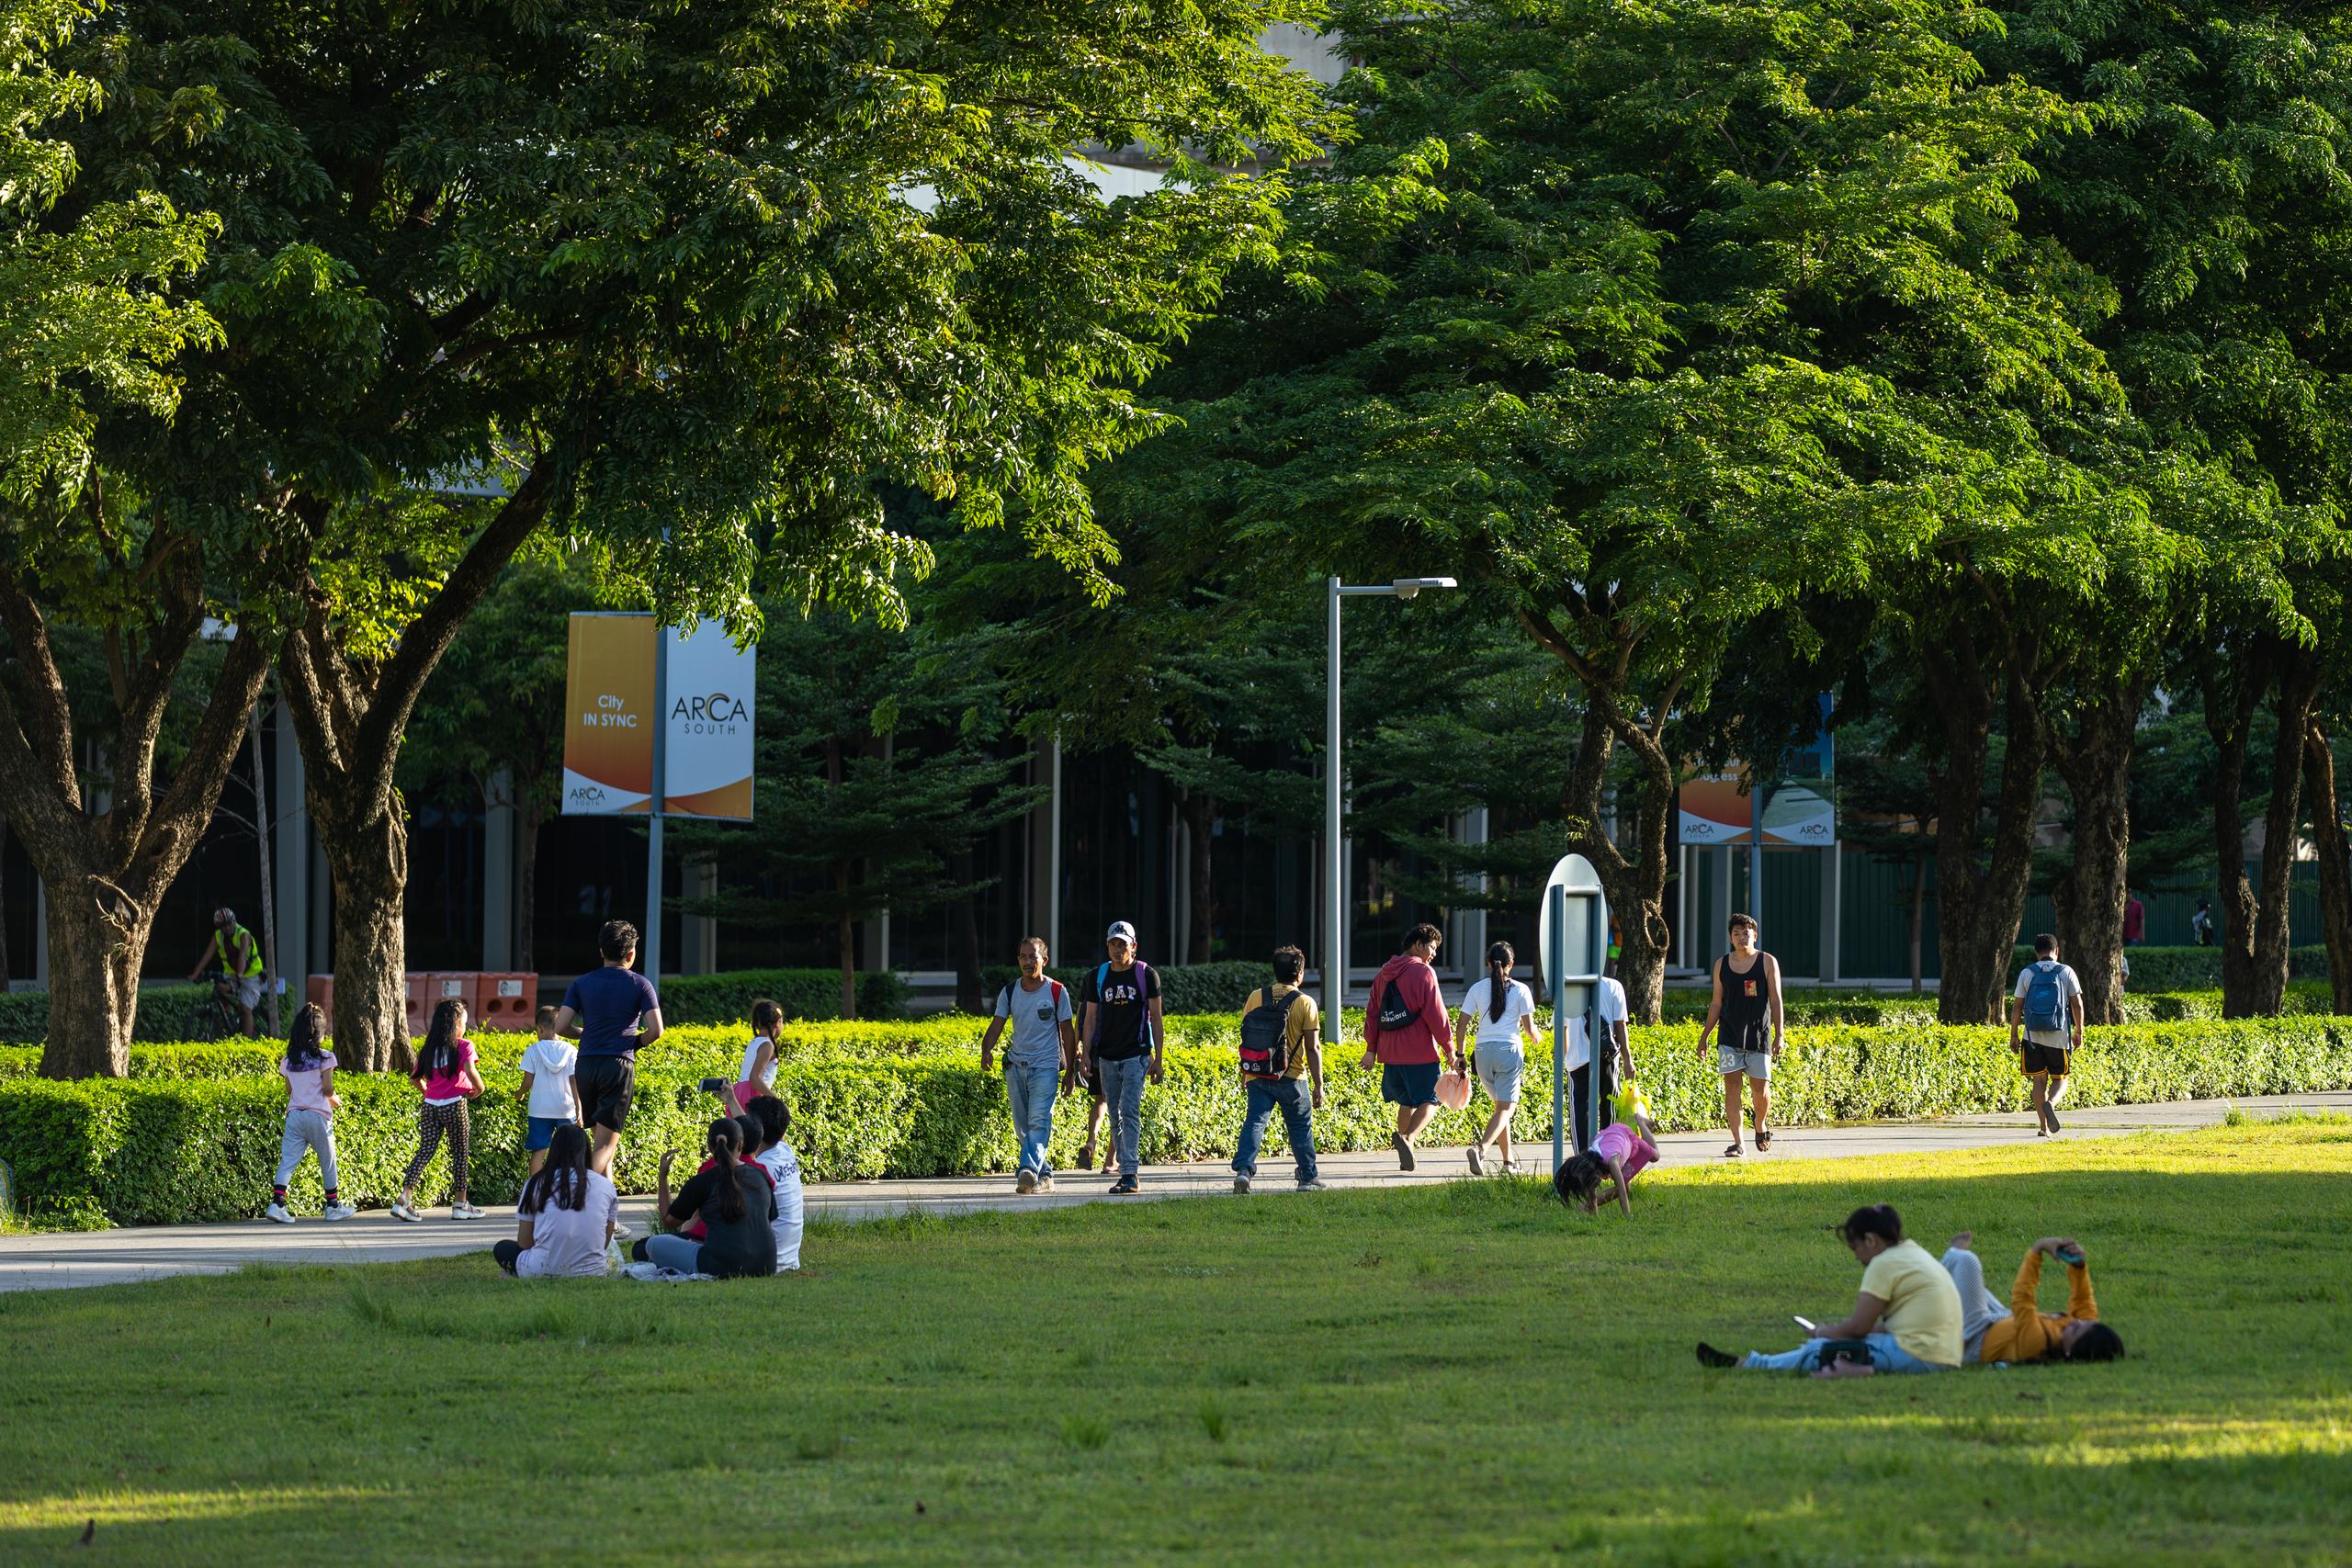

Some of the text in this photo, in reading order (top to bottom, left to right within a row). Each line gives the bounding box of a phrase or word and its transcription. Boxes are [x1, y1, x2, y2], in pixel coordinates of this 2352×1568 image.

[598, 694, 624, 712] City
[672, 693, 749, 722] ARCA
[583, 713, 638, 728] IN SYNC
[684, 723, 735, 735] SOUTH
[570, 786, 605, 801] ARCA
[1684, 823, 1714, 834] ARCA
[1800, 824, 1829, 835] ARCA
[1105, 985, 1136, 1002] GAP
[1721, 1054, 1736, 1067] 23
